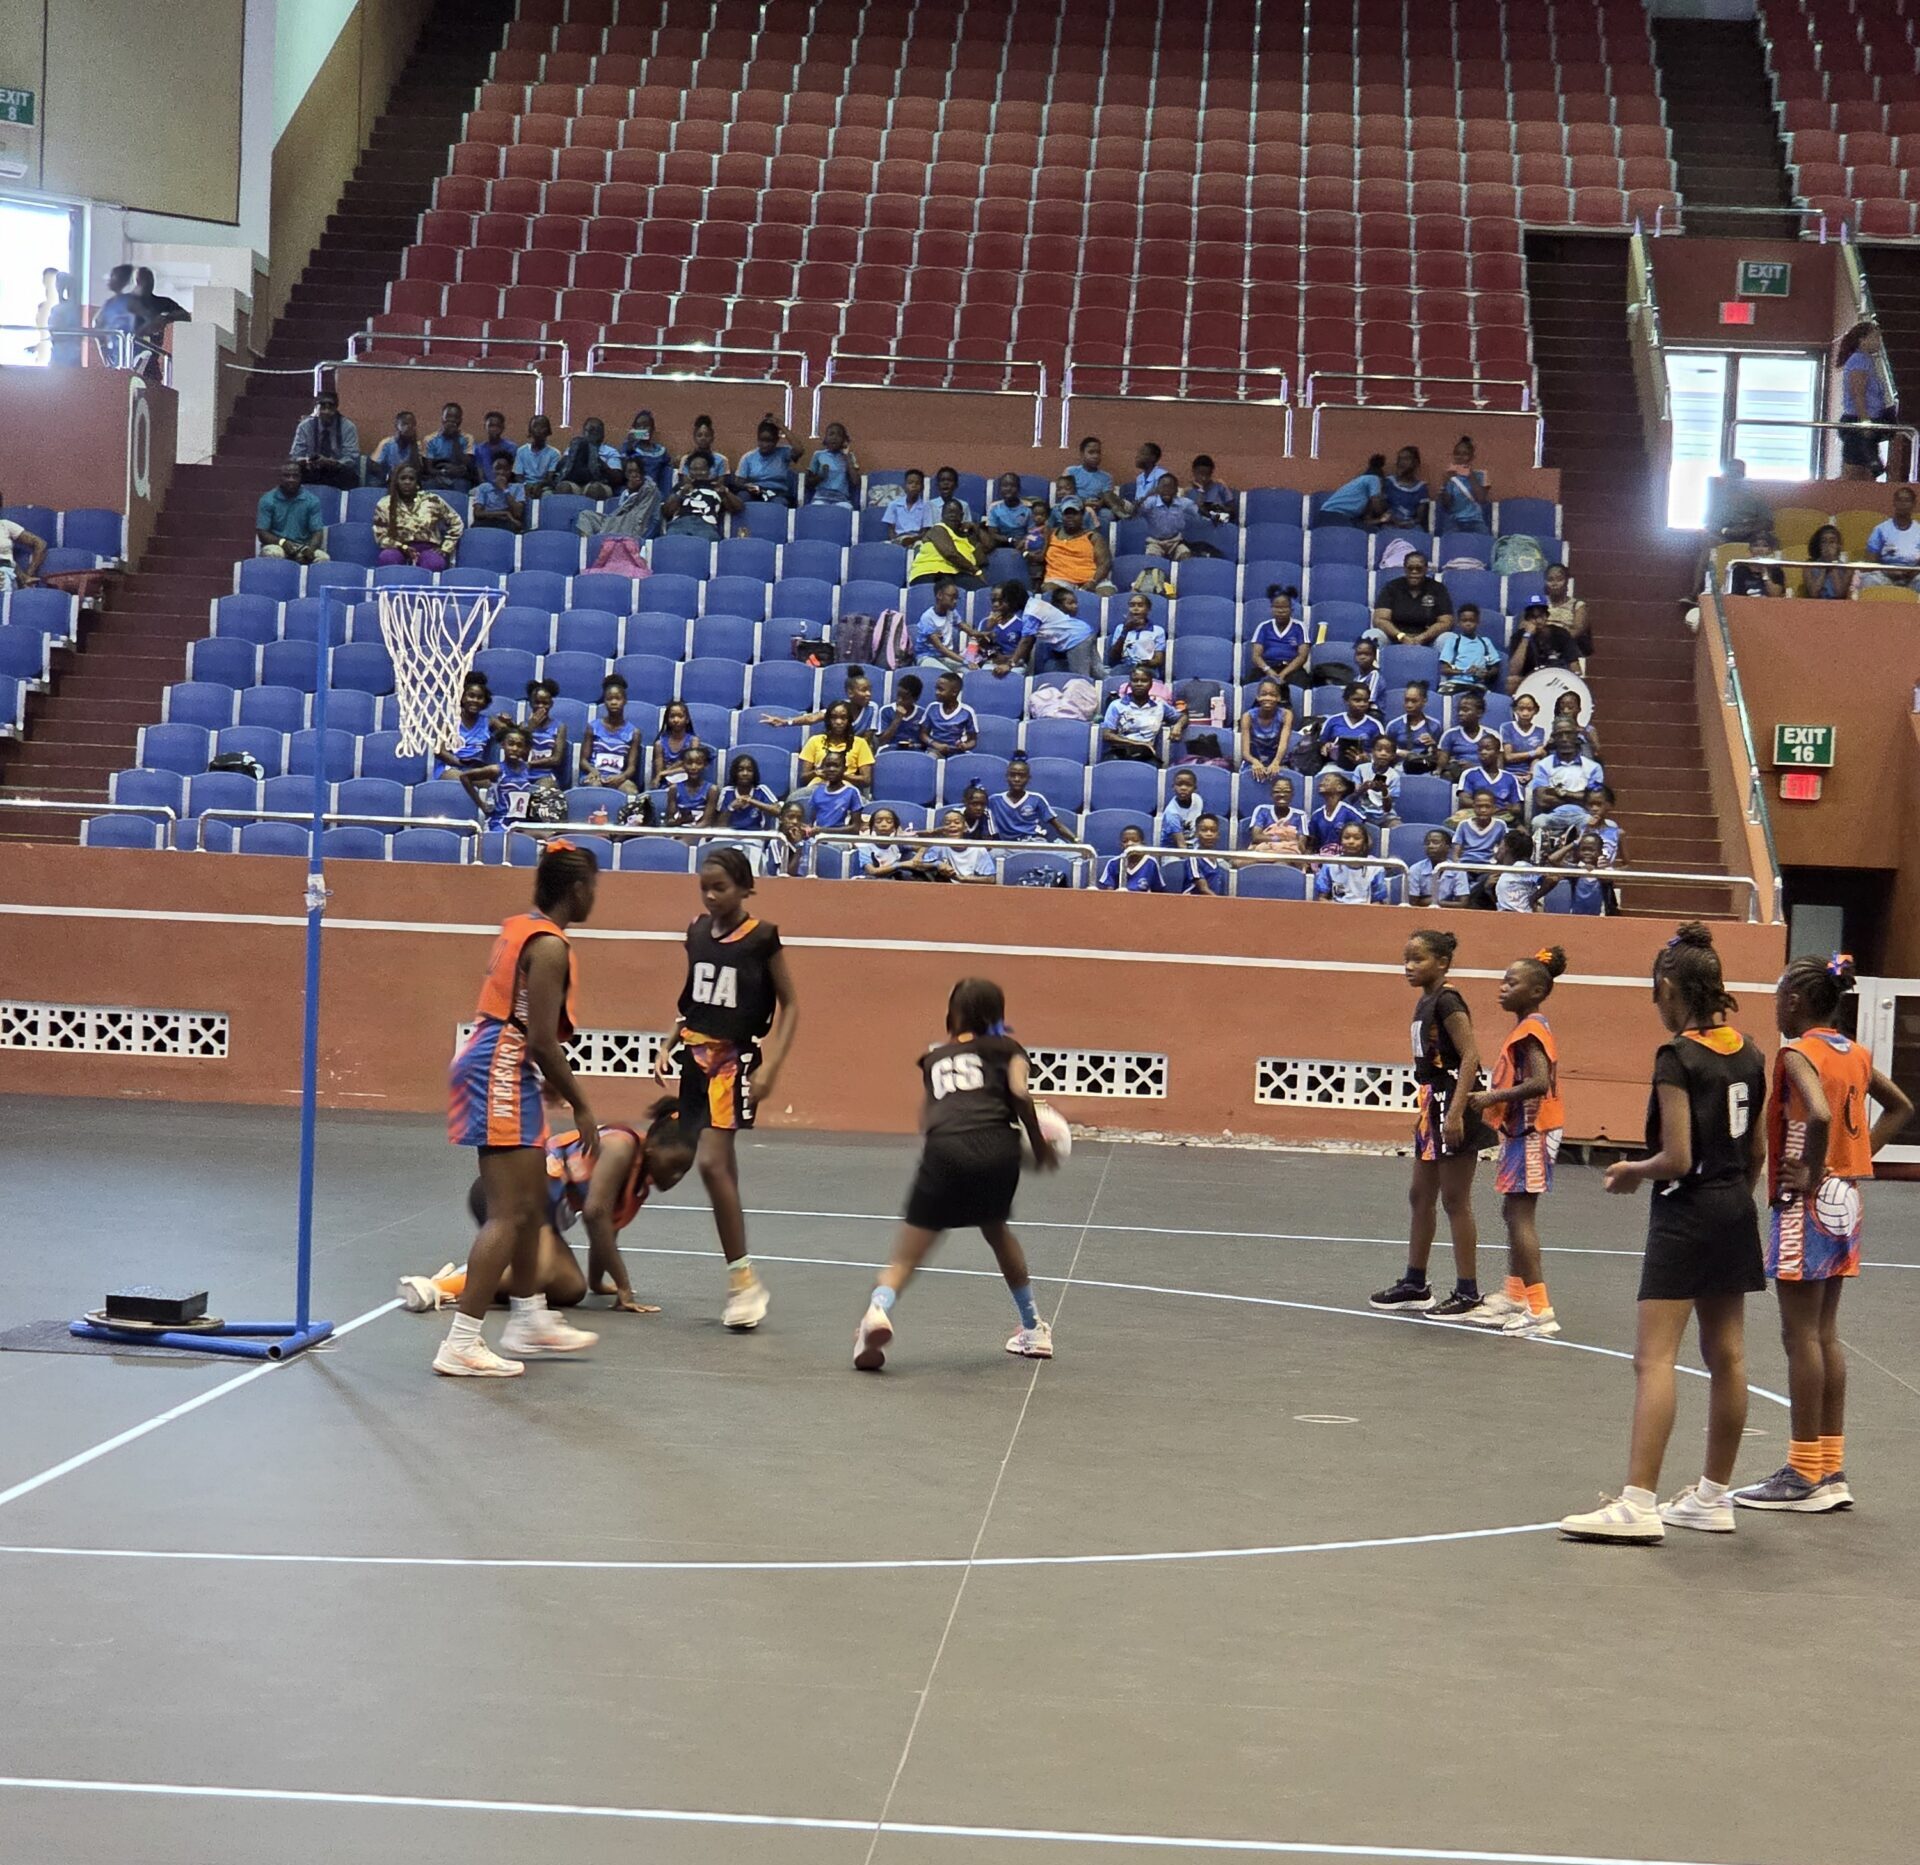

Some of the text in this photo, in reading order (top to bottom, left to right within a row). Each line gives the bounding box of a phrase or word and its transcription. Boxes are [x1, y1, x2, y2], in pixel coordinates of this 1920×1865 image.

[8, 106, 17, 120] 8
[1748, 264, 1784, 279] EXIT
[1760, 280, 1770, 293] 7
[1784, 727, 1827, 745] EXIT
[1791, 745, 1815, 762] 16
[692, 962, 737, 1008] GA
[492, 1041, 520, 1118] CHISHOLM
[931, 1053, 984, 1100] GS
[1778, 1200, 1804, 1273] HISHOLM
